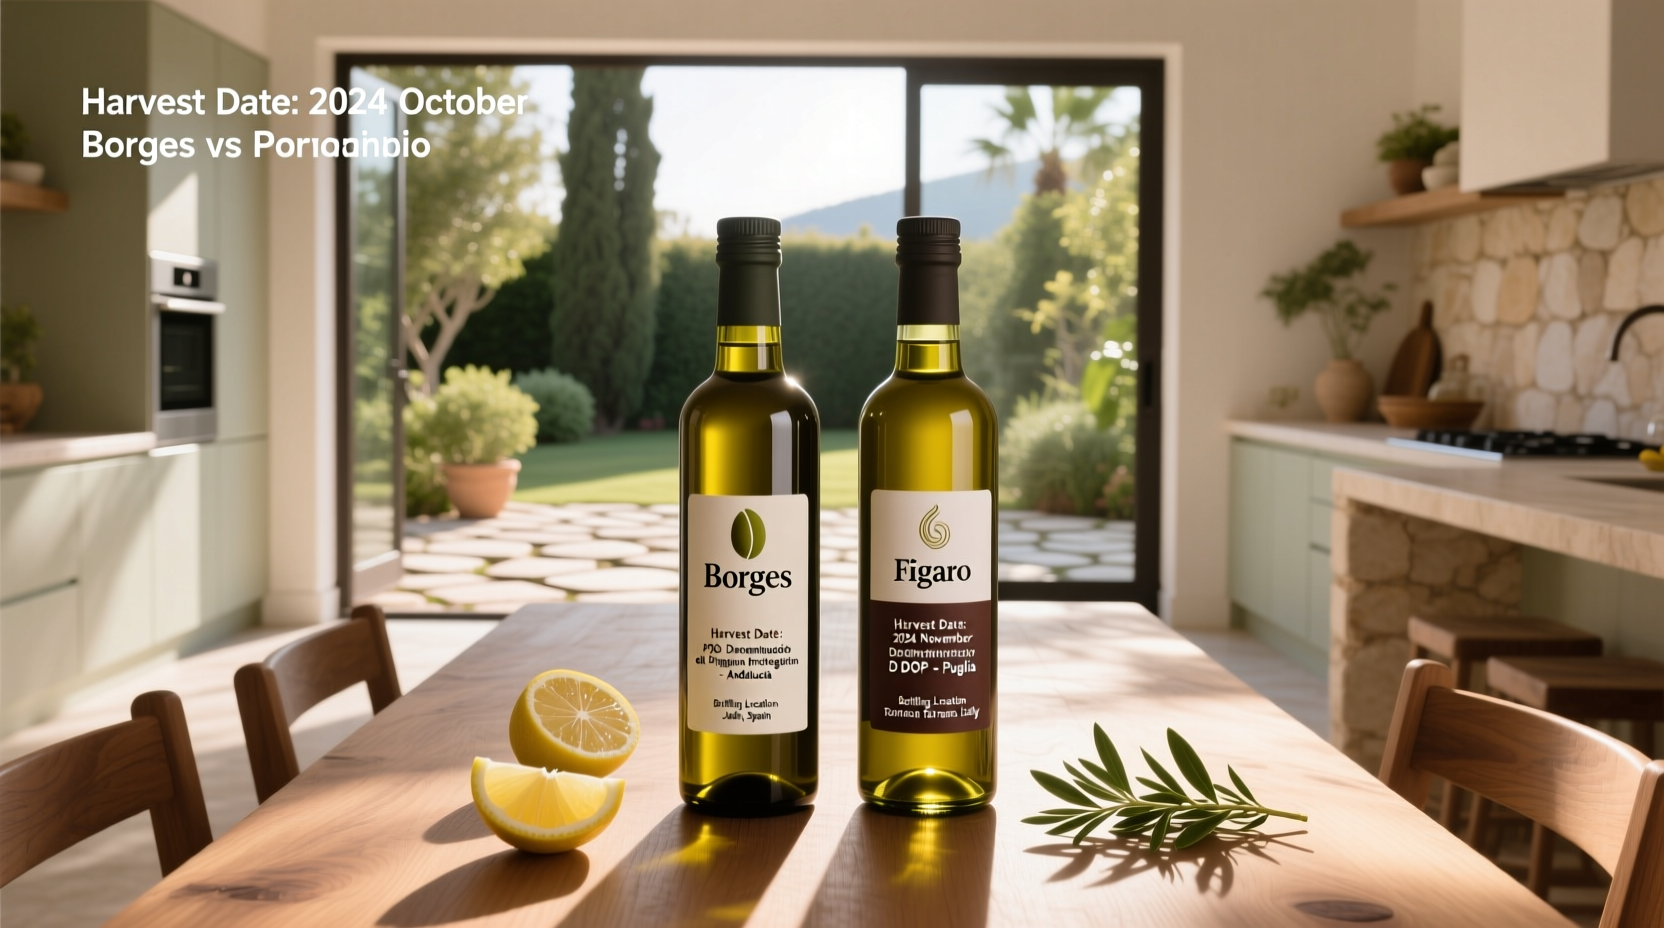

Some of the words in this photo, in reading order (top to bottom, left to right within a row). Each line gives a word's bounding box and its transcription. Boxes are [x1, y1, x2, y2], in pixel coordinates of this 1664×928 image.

[704, 563, 792, 596] Borges
[893, 558, 972, 589] Figaro
[711, 627, 751, 639] Harvest
[754, 628, 783, 639] Date:
[901, 660, 929, 674] DOP
[942, 660, 977, 677] Puglia
